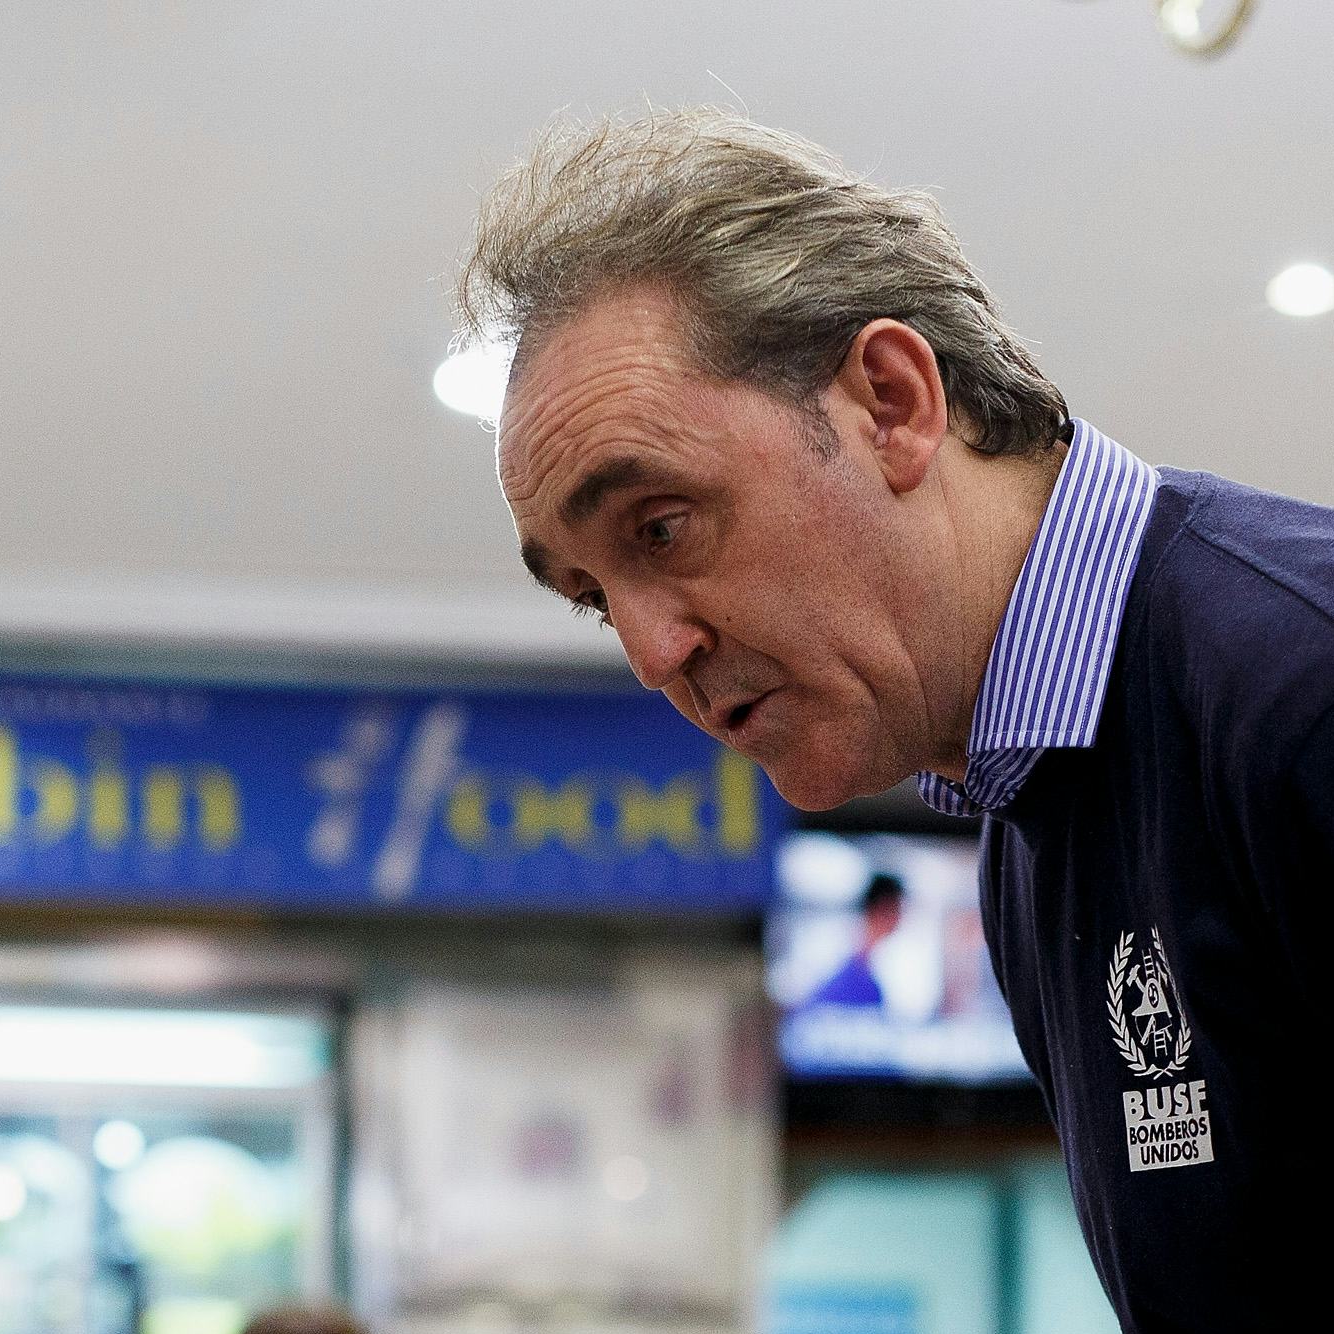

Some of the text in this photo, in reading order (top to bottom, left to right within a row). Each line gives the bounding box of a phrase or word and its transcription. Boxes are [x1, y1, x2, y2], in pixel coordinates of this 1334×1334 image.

[1122, 1079, 1207, 1121] BUSF
[1129, 1116, 1208, 1146] BOMBEROS
[1140, 1139, 1199, 1166] UNIDOS
